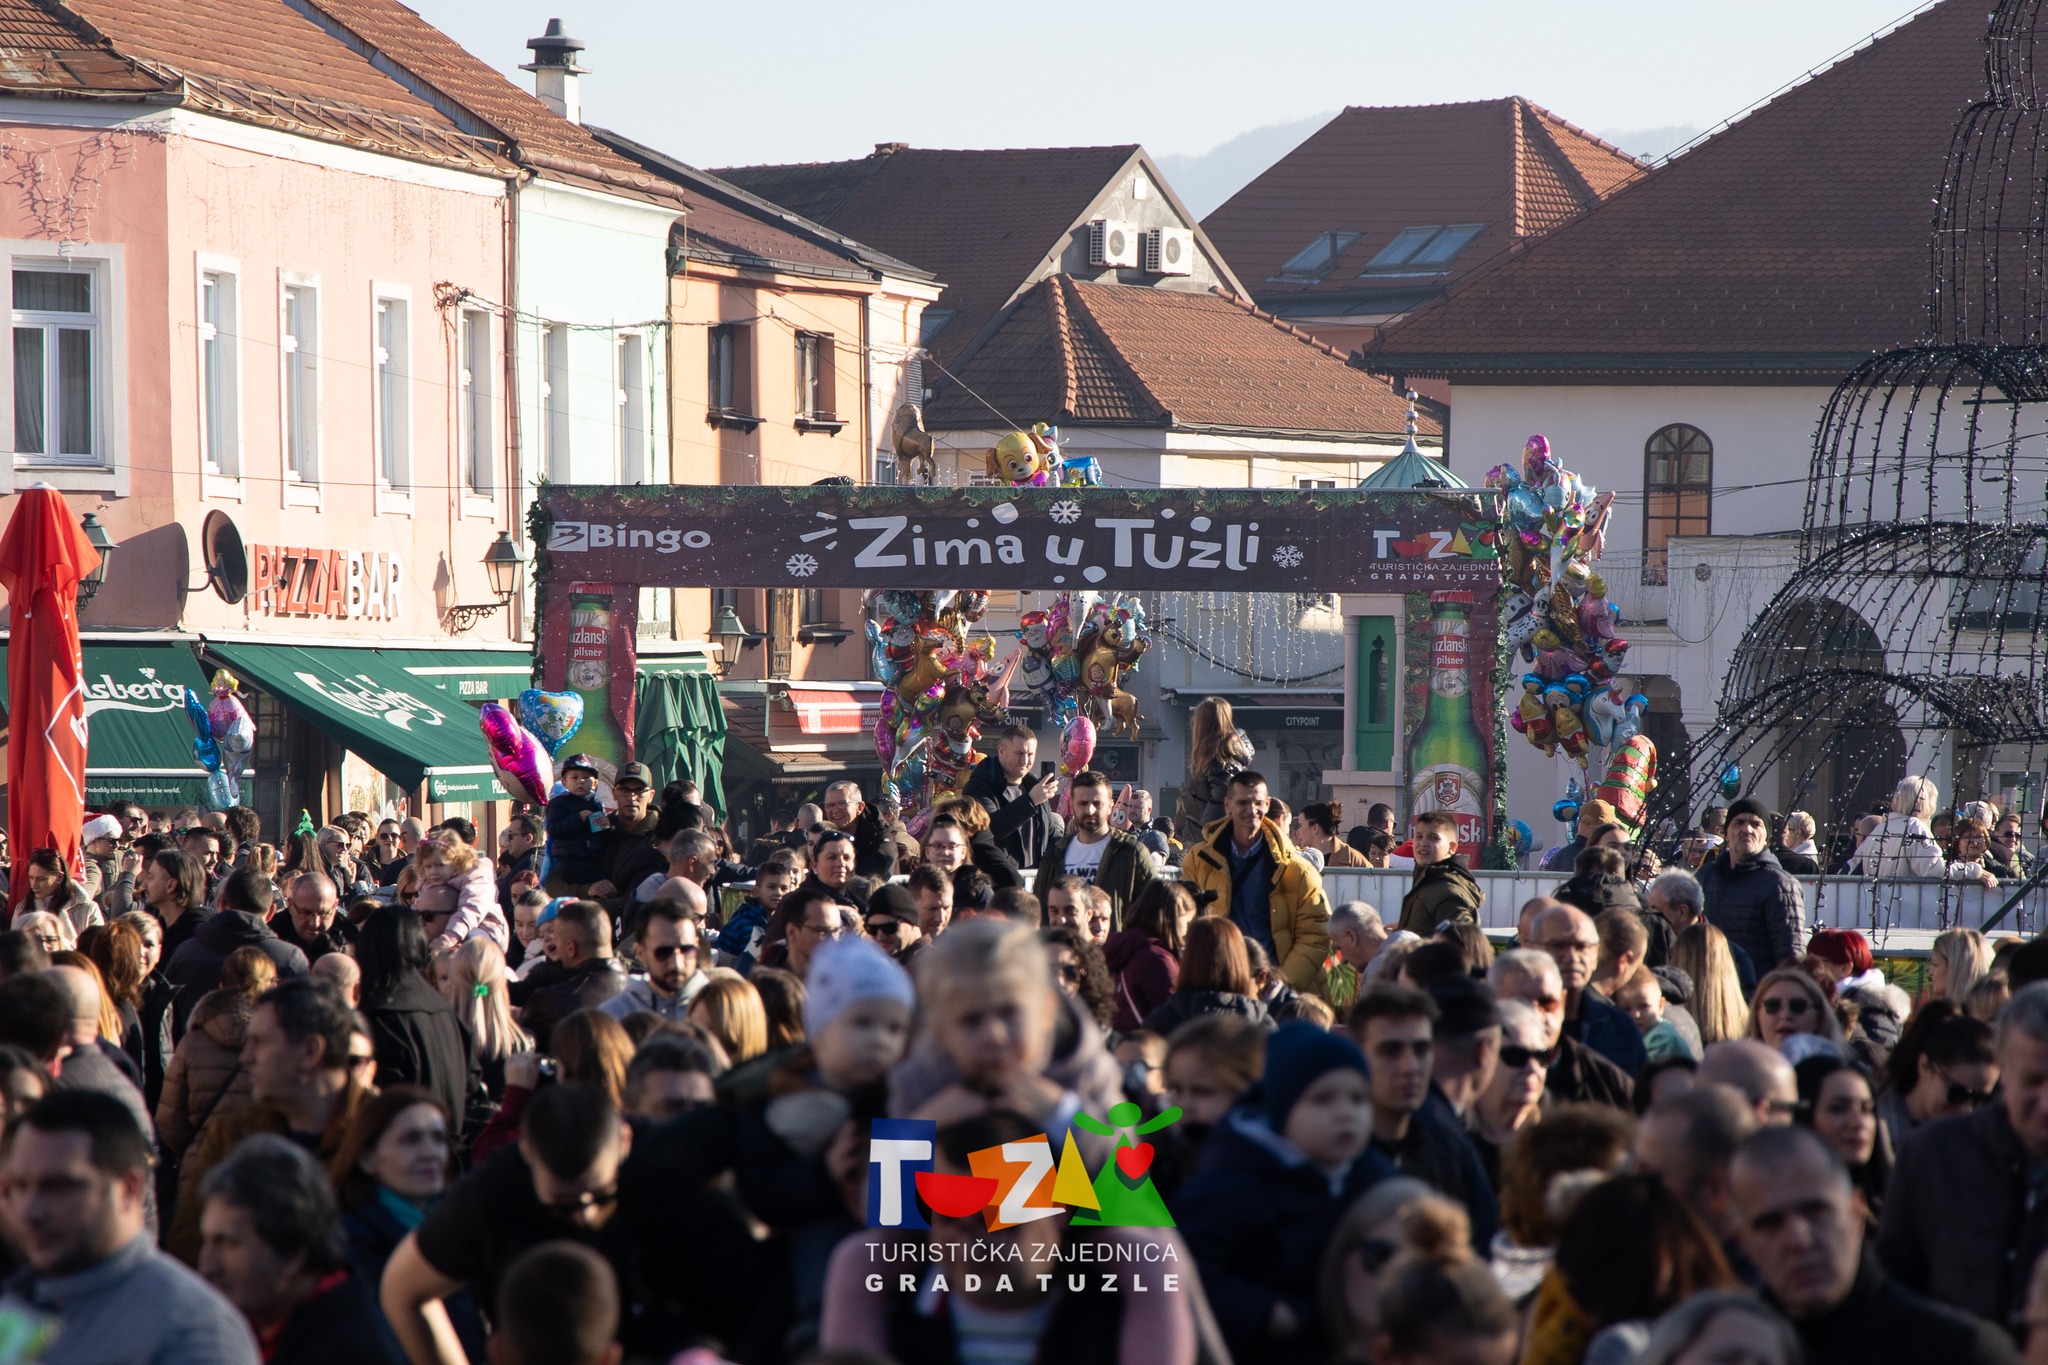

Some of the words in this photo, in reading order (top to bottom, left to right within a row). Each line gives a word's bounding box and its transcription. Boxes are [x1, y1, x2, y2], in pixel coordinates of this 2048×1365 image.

[590, 523, 711, 554] Bingo
[848, 514, 1025, 568] Zima
[1045, 535, 1084, 566] u
[1370, 562, 1439, 571] TURISTIČKA
[574, 647, 603, 658] pilsner
[1436, 655, 1464, 667] pilsner
[459, 681, 475, 695] PIZZA
[475, 681, 488, 695] BAR
